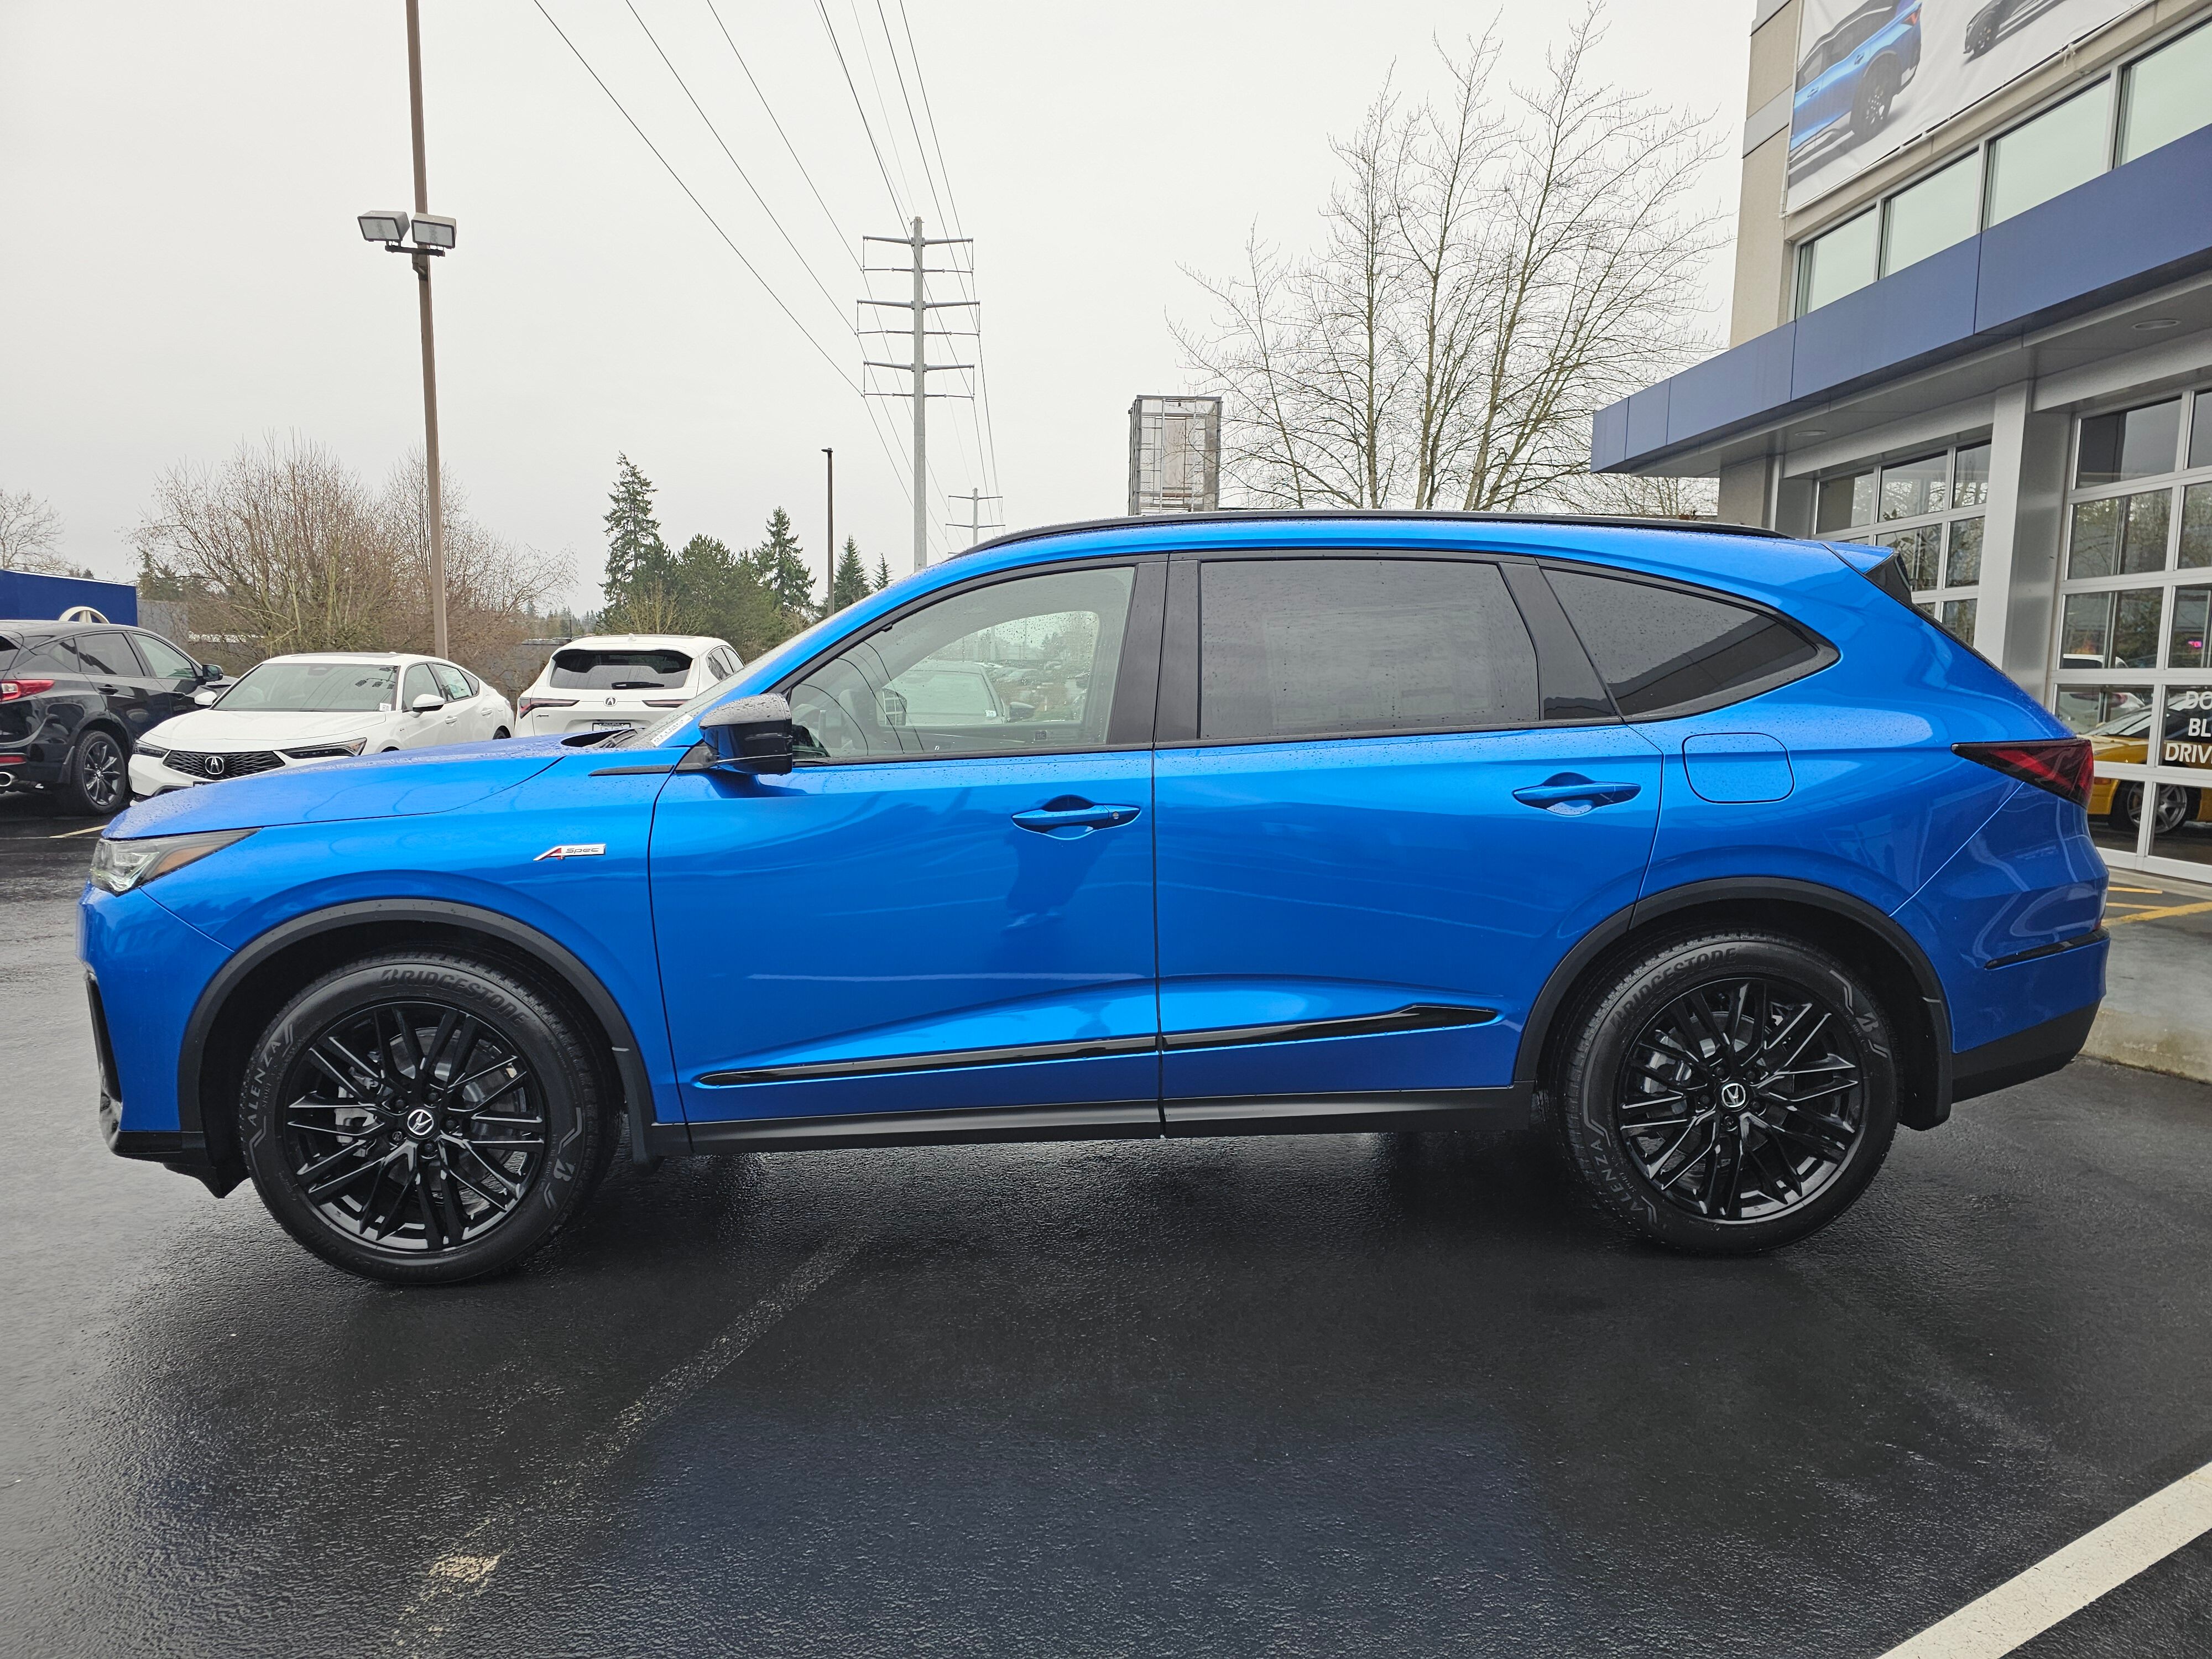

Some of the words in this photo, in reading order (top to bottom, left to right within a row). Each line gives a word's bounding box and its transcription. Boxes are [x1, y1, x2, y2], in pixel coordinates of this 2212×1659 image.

[2164, 742, 2212, 764] DRIV
[379, 968, 530, 1027] BRIDGESTONE
[1609, 947, 1737, 1033] BRIDGESTONE
[247, 1040, 281, 1126] ALENZA
[1590, 1139, 1645, 1211] ALENZA
